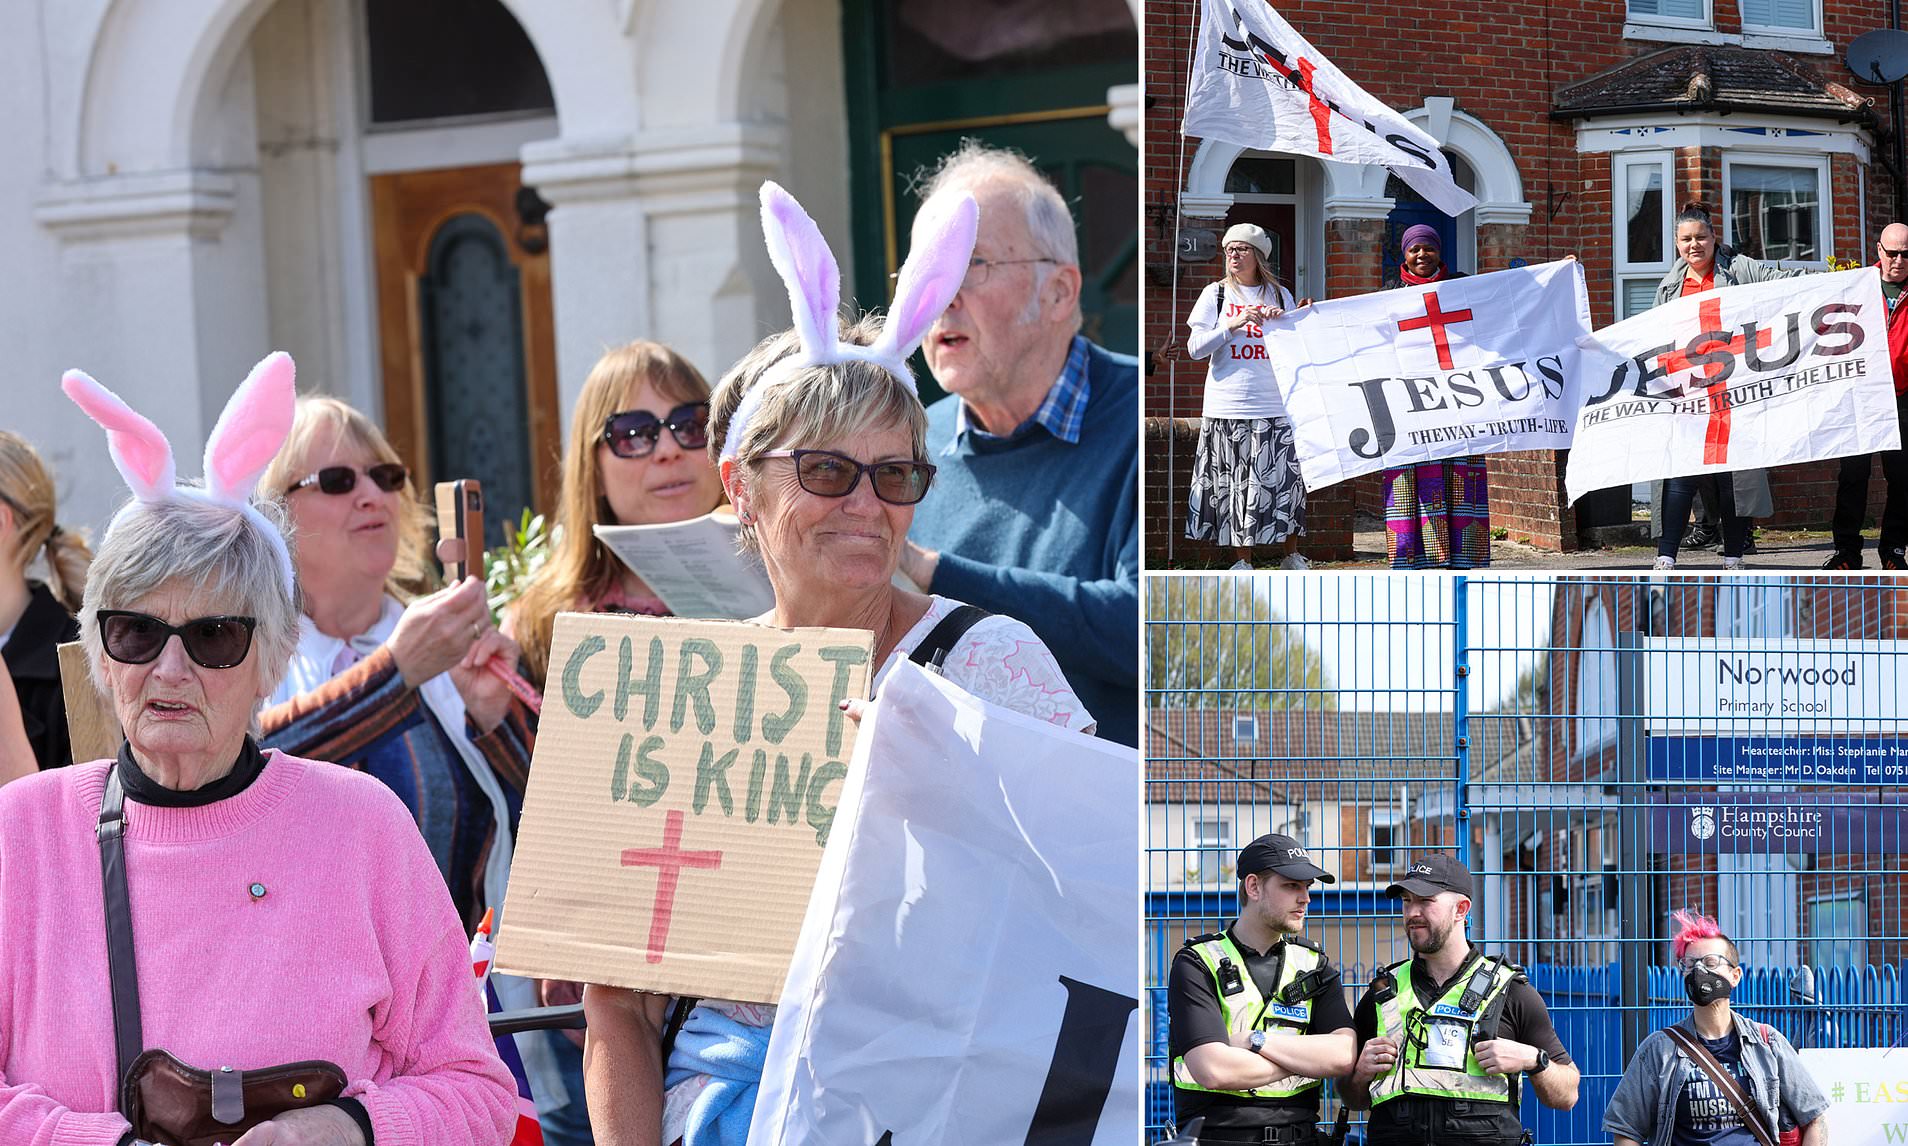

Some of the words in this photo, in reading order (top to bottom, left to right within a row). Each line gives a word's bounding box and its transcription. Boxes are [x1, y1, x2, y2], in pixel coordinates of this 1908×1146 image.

[1218, 53, 1250, 75] THE
[1183, 238, 1197, 252] 31
[1246, 324, 1263, 339] IS
[1230, 344, 1270, 360] LOR
[1585, 303, 1866, 407] JESUS
[1583, 406, 1611, 429] THE
[1615, 401, 1660, 417] WAY
[1671, 399, 1707, 415] THE
[1712, 382, 1773, 411] TRUTH
[1784, 365, 1820, 391] THE
[1826, 358, 1867, 381] LIFE
[1348, 355, 1565, 459] JESUS
[1718, 659, 1856, 686] Norwood
[561, 634, 869, 758] CHRIST
[1719, 698, 1775, 716] Primary
[1781, 698, 1827, 713] School
[1838, 745, 1887, 759] Stephanie
[1713, 765, 1732, 775] Site
[1736, 765, 1782, 778] Manager:
[1785, 765, 1799, 775] Mr
[1803, 765, 1814, 775] D.
[1816, 765, 1856, 775] Oakden
[611, 733, 670, 808] IS
[692, 740, 848, 848] KING
[1722, 806, 1822, 828] Hampshire
[1721, 825, 1767, 840] County
[1773, 825, 1822, 837] Councl
[1273, 1006, 1307, 1018] POLICE
[1436, 1005, 1475, 1018] POLIC
[1689, 1099, 1737, 1117] HUSBA
